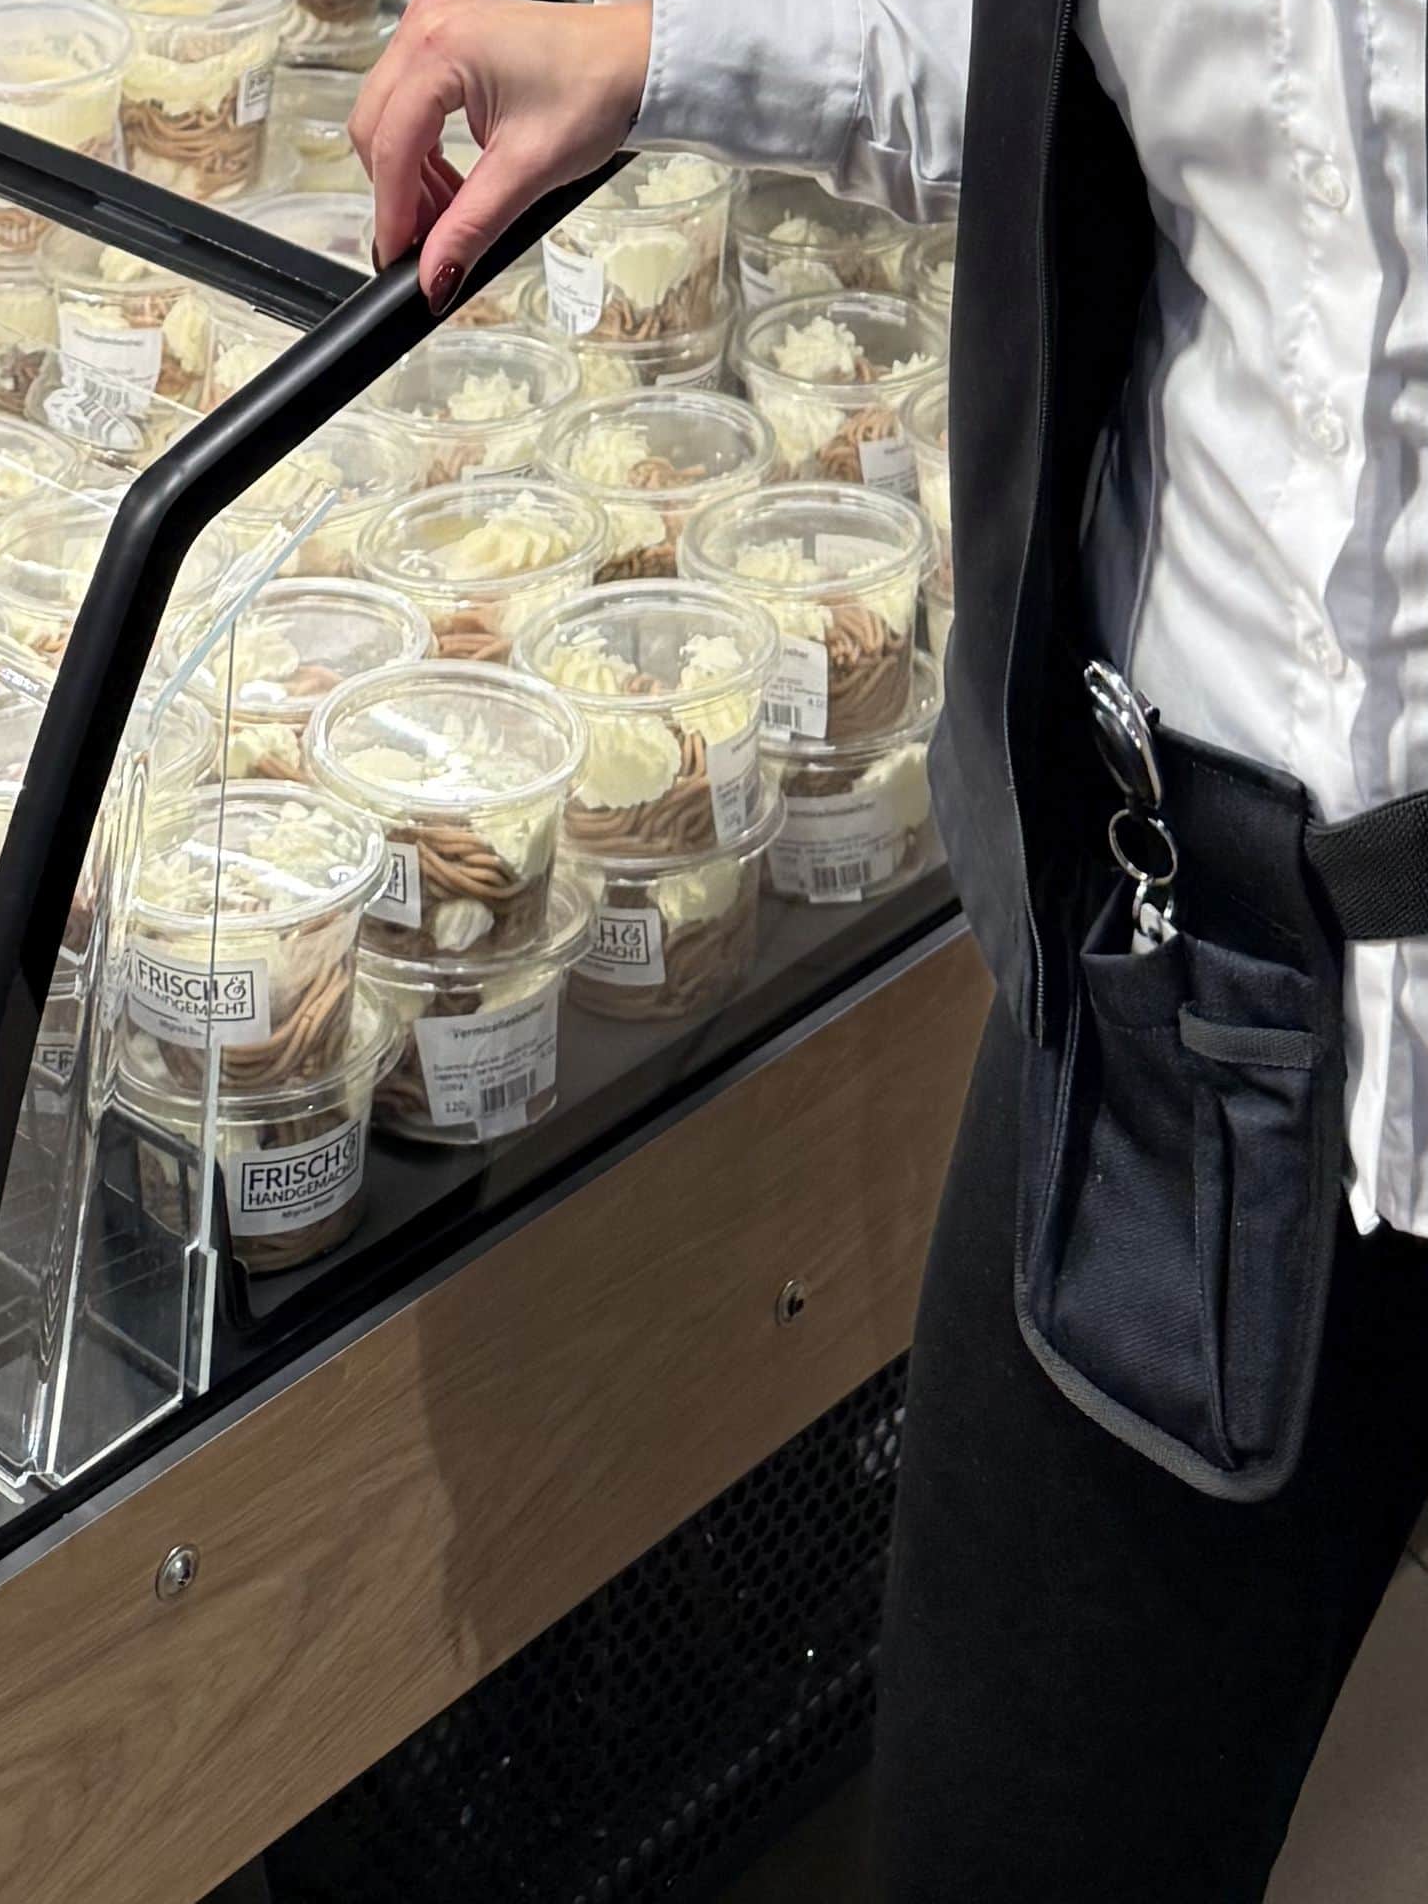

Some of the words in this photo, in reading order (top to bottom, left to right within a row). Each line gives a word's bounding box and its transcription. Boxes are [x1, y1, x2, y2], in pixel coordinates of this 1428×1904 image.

[138, 960, 219, 1001] FRISCH
[224, 976, 246, 1000] &
[249, 1144, 340, 1191] FRISCH
